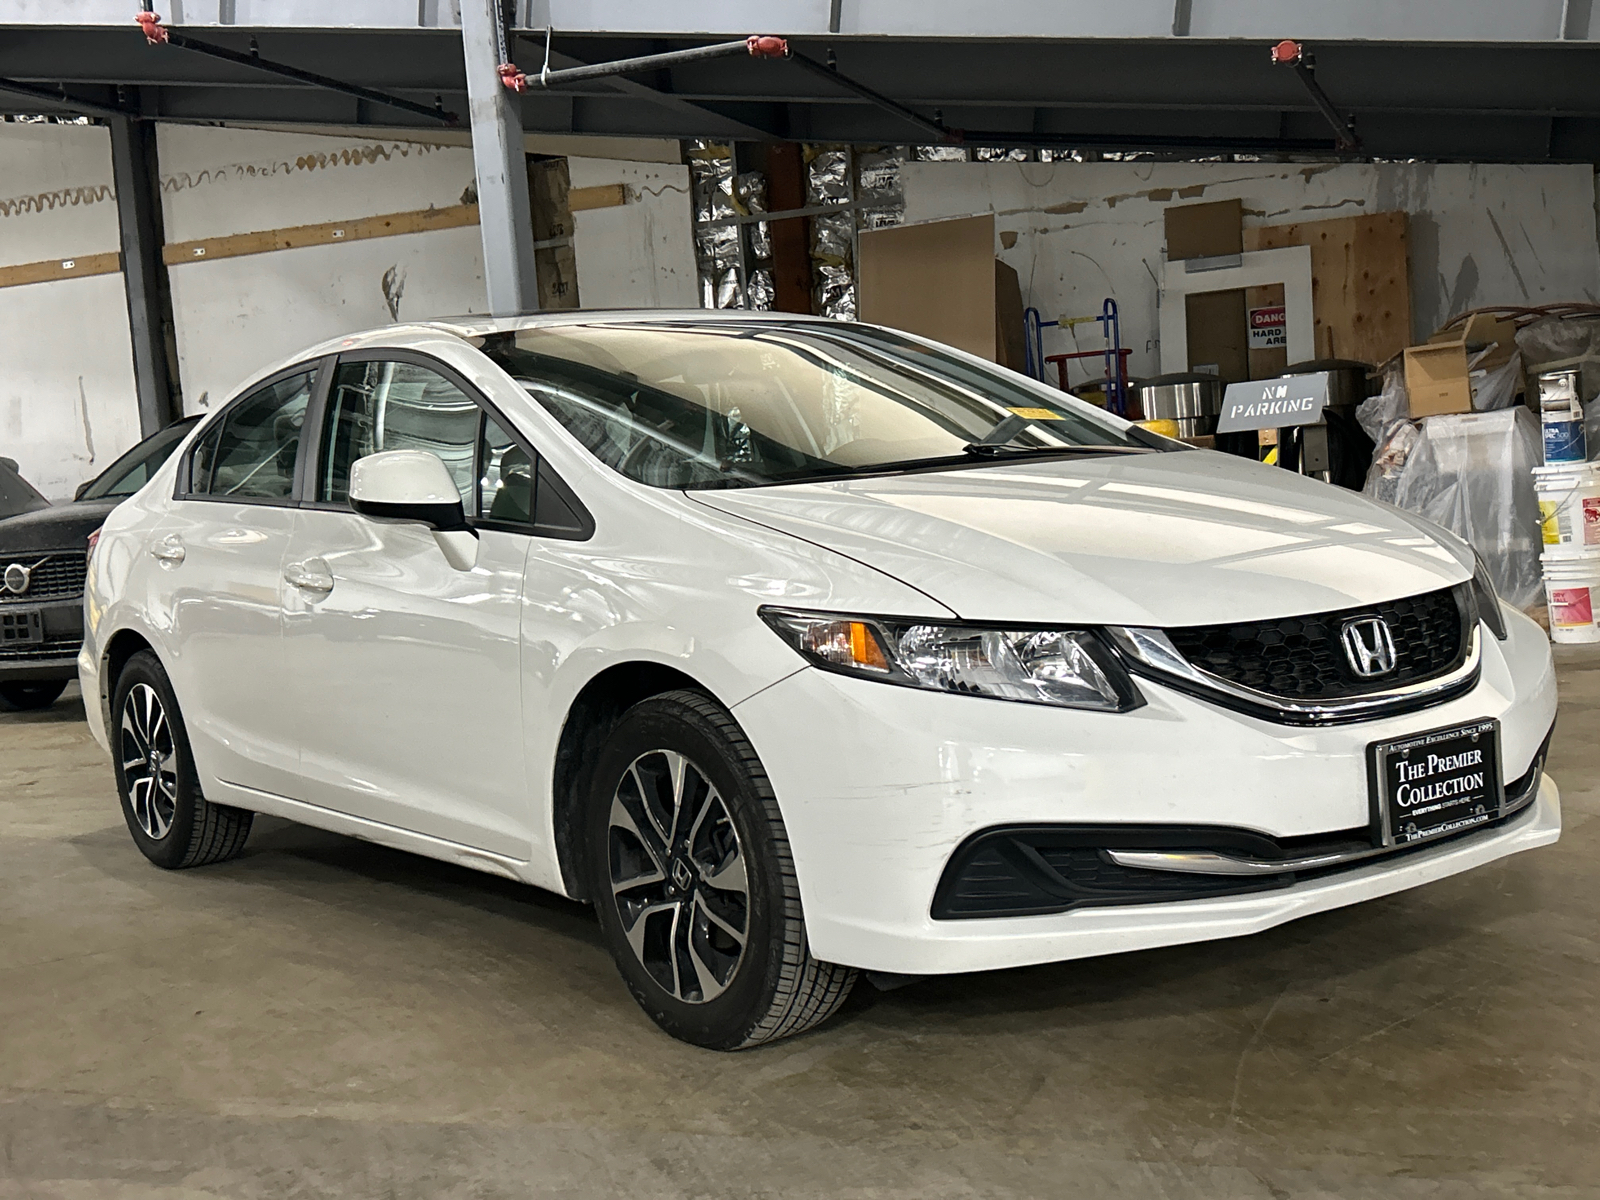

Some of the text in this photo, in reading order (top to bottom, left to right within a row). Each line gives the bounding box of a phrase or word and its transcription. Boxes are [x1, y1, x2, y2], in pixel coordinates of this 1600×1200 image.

[1253, 329, 1281, 337] HARD
[1230, 397, 1314, 419] PARKING
[1426, 731, 1460, 744] EXCELLENCE
[1478, 723, 1493, 732] 1995
[1395, 749, 1483, 783] THE PREMIER
[1396, 772, 1484, 808] COLLECTION
